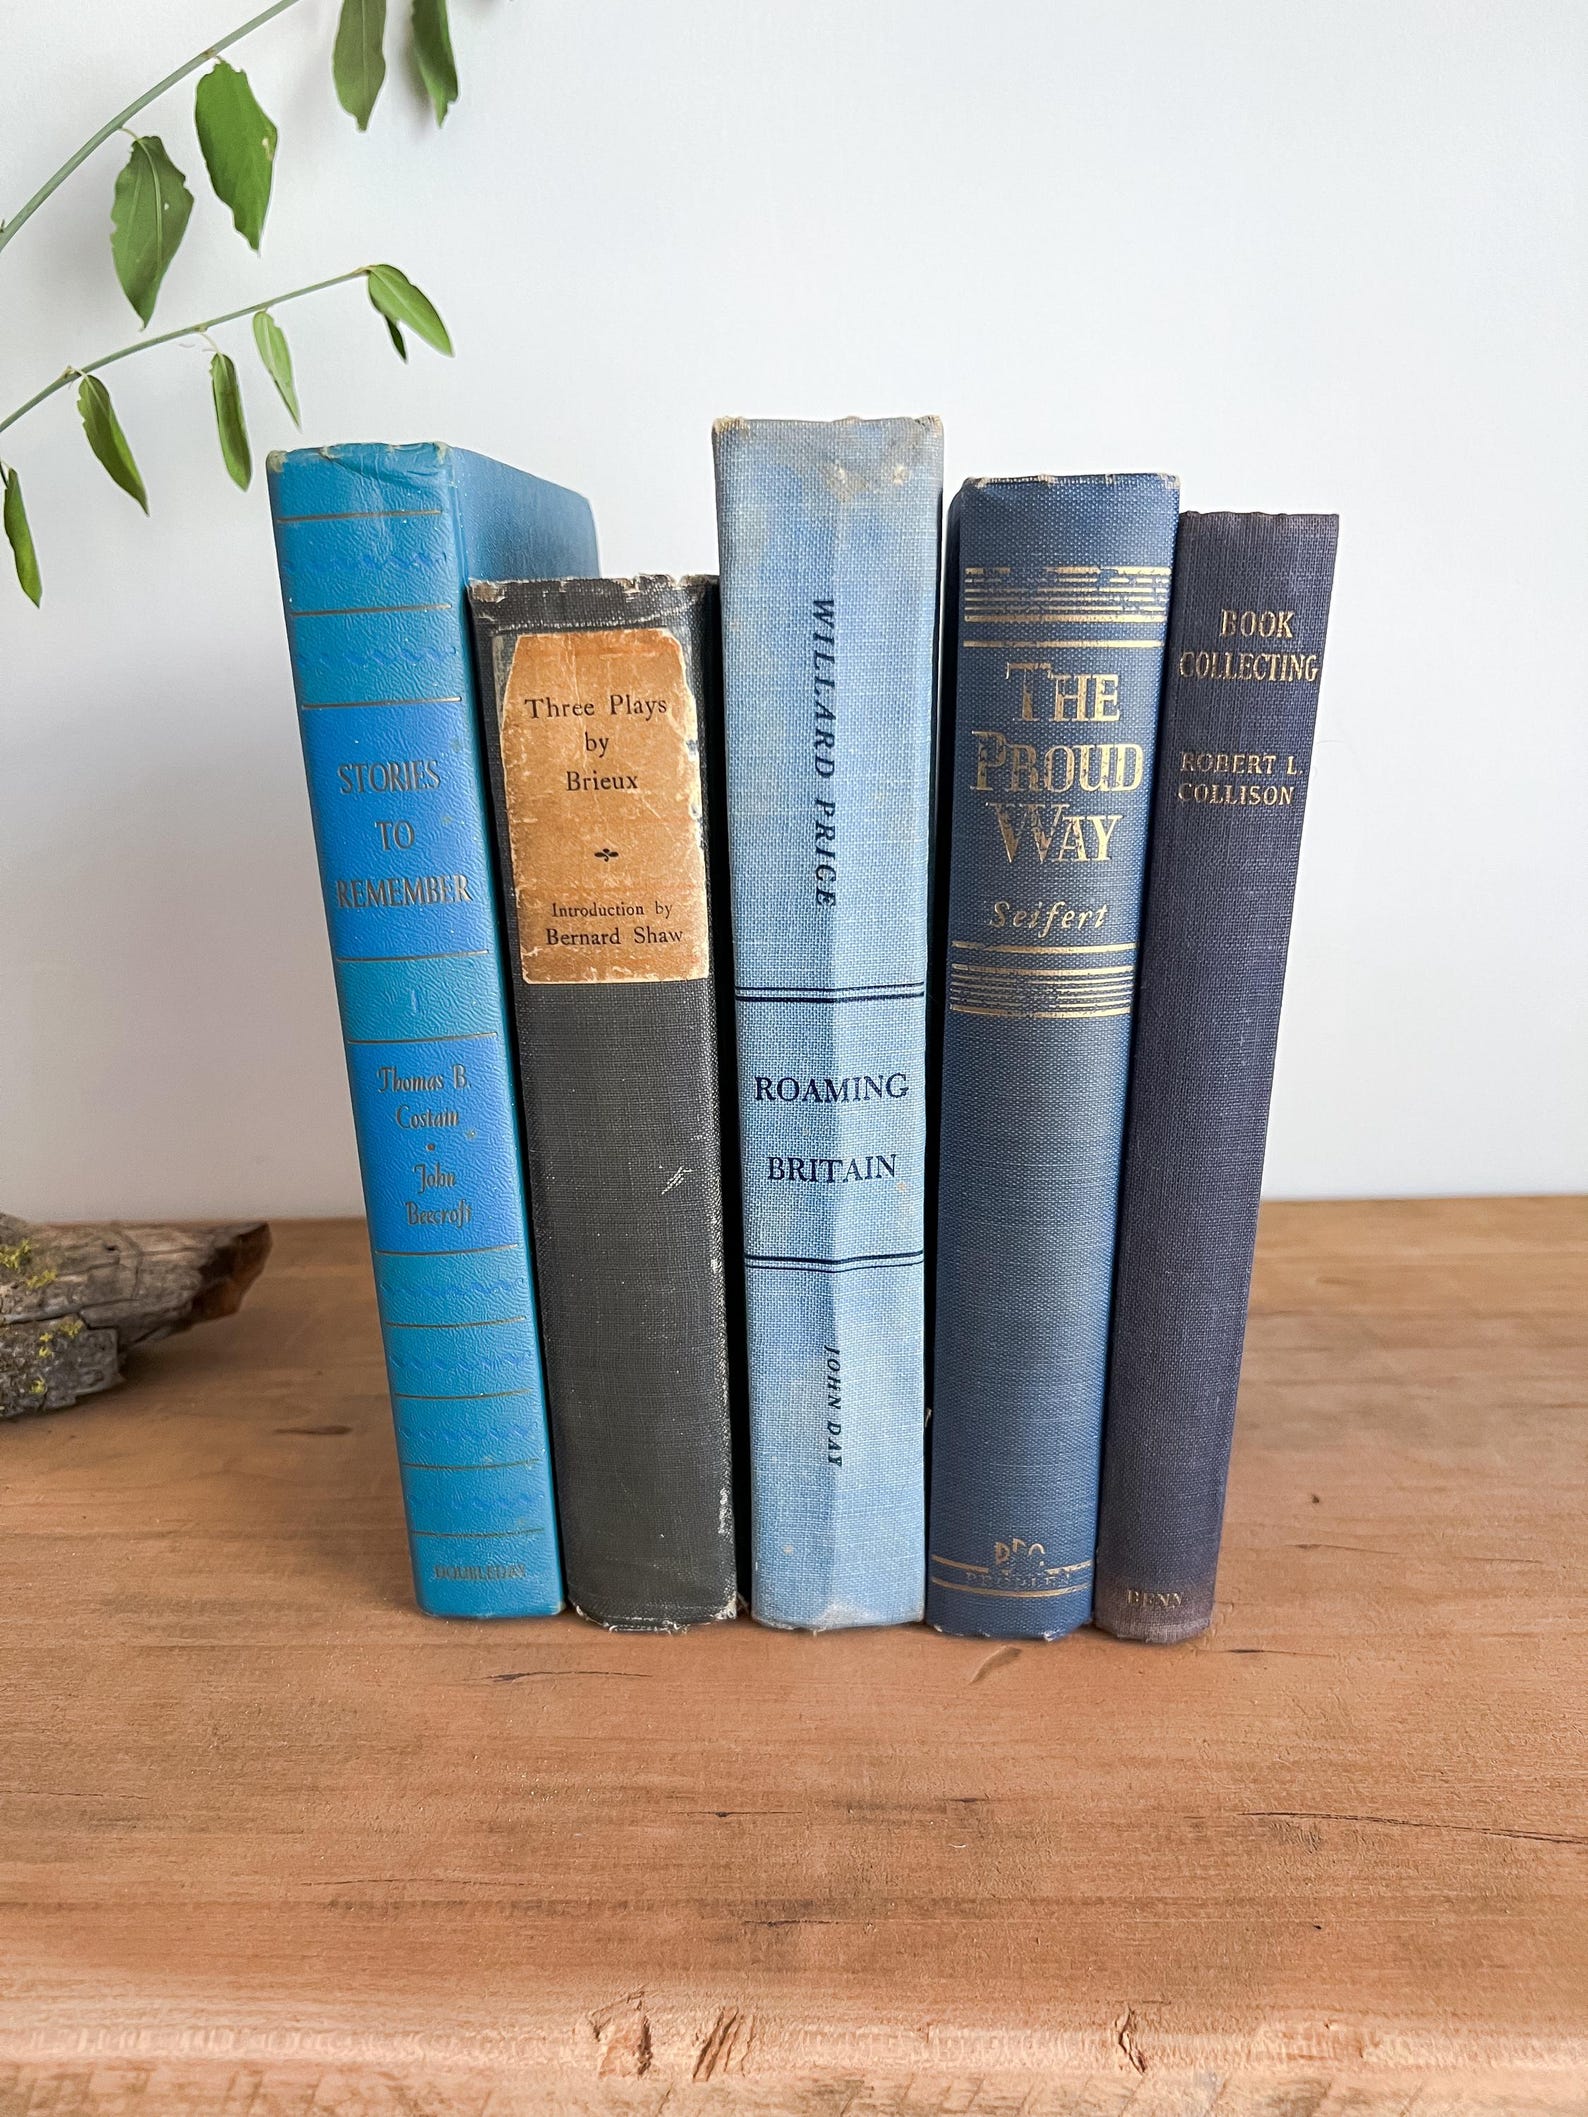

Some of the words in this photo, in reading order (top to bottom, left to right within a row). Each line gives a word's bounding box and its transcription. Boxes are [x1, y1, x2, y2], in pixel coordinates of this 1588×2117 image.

[1219, 608, 1296, 639] BOOK
[1178, 650, 1320, 683] COLLECTING
[812, 598, 837, 780] WILLARD
[1005, 661, 1122, 723] THE
[524, 695, 596, 720] Three
[610, 693, 668, 722] Plays
[584, 731, 610, 759] by
[970, 730, 1145, 793] PROUD
[1178, 750, 1277, 776] ROBERT
[1285, 755, 1304, 776] L.
[337, 760, 441, 796] STORIES
[566, 770, 639, 793] Brieux
[1176, 782, 1296, 807] COLLISON
[374, 819, 415, 851] TO
[985, 801, 1124, 863] WAY
[814, 797, 837, 908] PRICE
[336, 873, 473, 909] REMEMBER
[551, 901, 645, 919] Introduction
[655, 900, 674, 920] by
[989, 900, 1109, 939] Seifert
[545, 927, 621, 947] Bernard
[633, 925, 684, 945] Shaw
[377, 1065, 444, 1094] Thomas
[453, 1062, 473, 1091] B.
[755, 1071, 910, 1104] ROAMING
[396, 1104, 460, 1130] Costain
[412, 1162, 456, 1195] John
[767, 1153, 898, 1184] BRITAIN
[404, 1199, 473, 1231] Beecroft
[823, 1344, 842, 1411] JOHN
[826, 1419, 843, 1468] DAY
